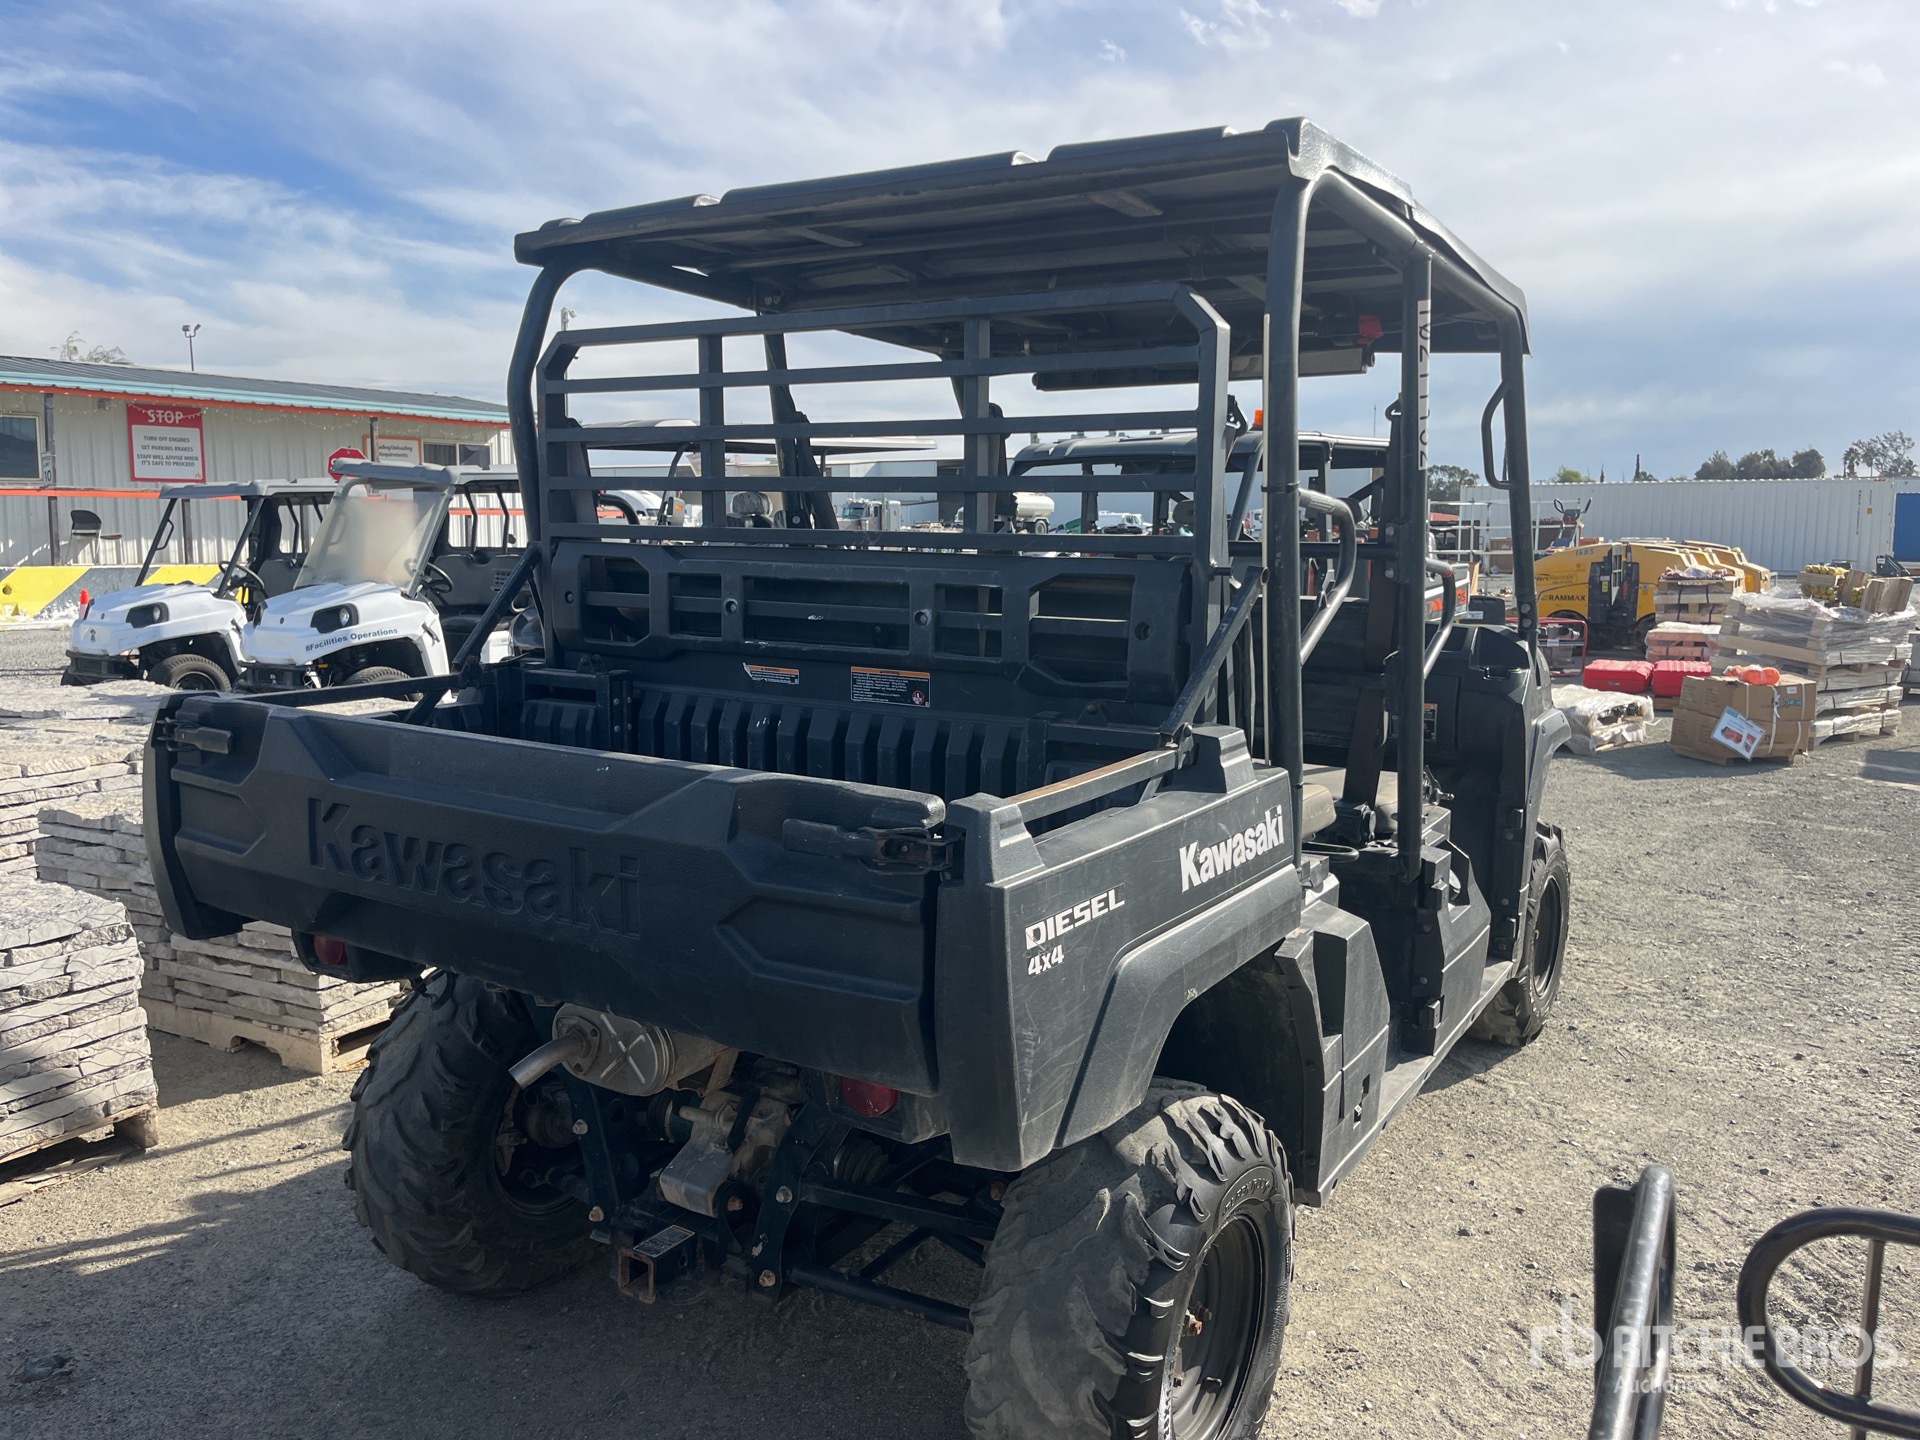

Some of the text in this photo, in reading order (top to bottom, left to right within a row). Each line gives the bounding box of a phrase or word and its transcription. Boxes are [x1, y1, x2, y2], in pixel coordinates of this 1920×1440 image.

[147, 409, 184, 424] STOP
[350, 628, 398, 641] Operations
[307, 797, 641, 940] Kawasaki
[1179, 804, 1284, 893] Kawasaki
[1025, 888, 1125, 950] DIESEL
[1027, 945, 1065, 976] 4x4
